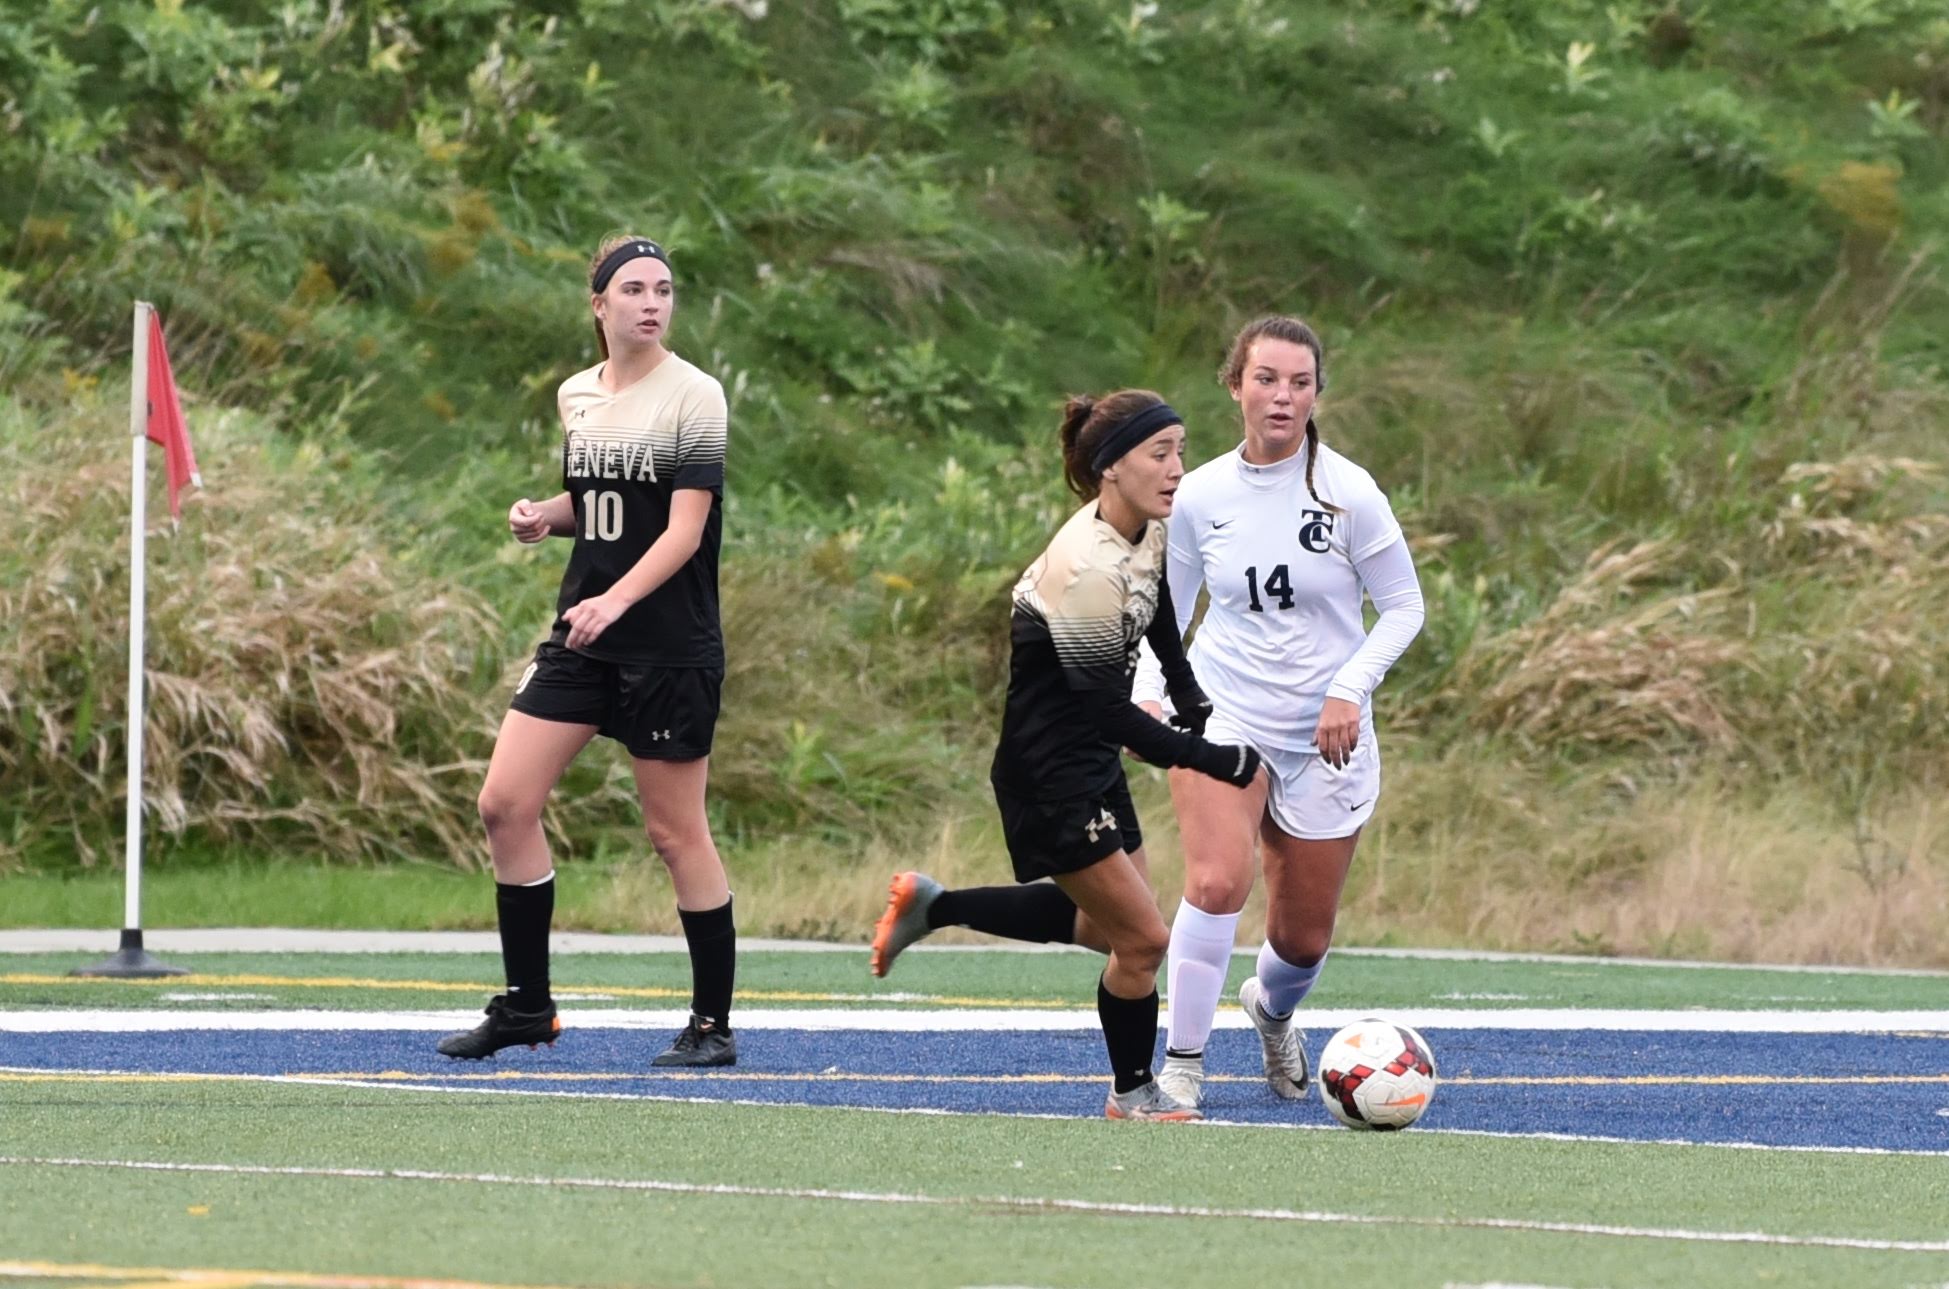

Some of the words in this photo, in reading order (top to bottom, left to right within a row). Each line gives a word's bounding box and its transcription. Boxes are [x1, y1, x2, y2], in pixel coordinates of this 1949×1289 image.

[567, 439, 657, 483] ENEVA
[583, 490, 623, 541] 10
[1244, 564, 1295, 612] 14
